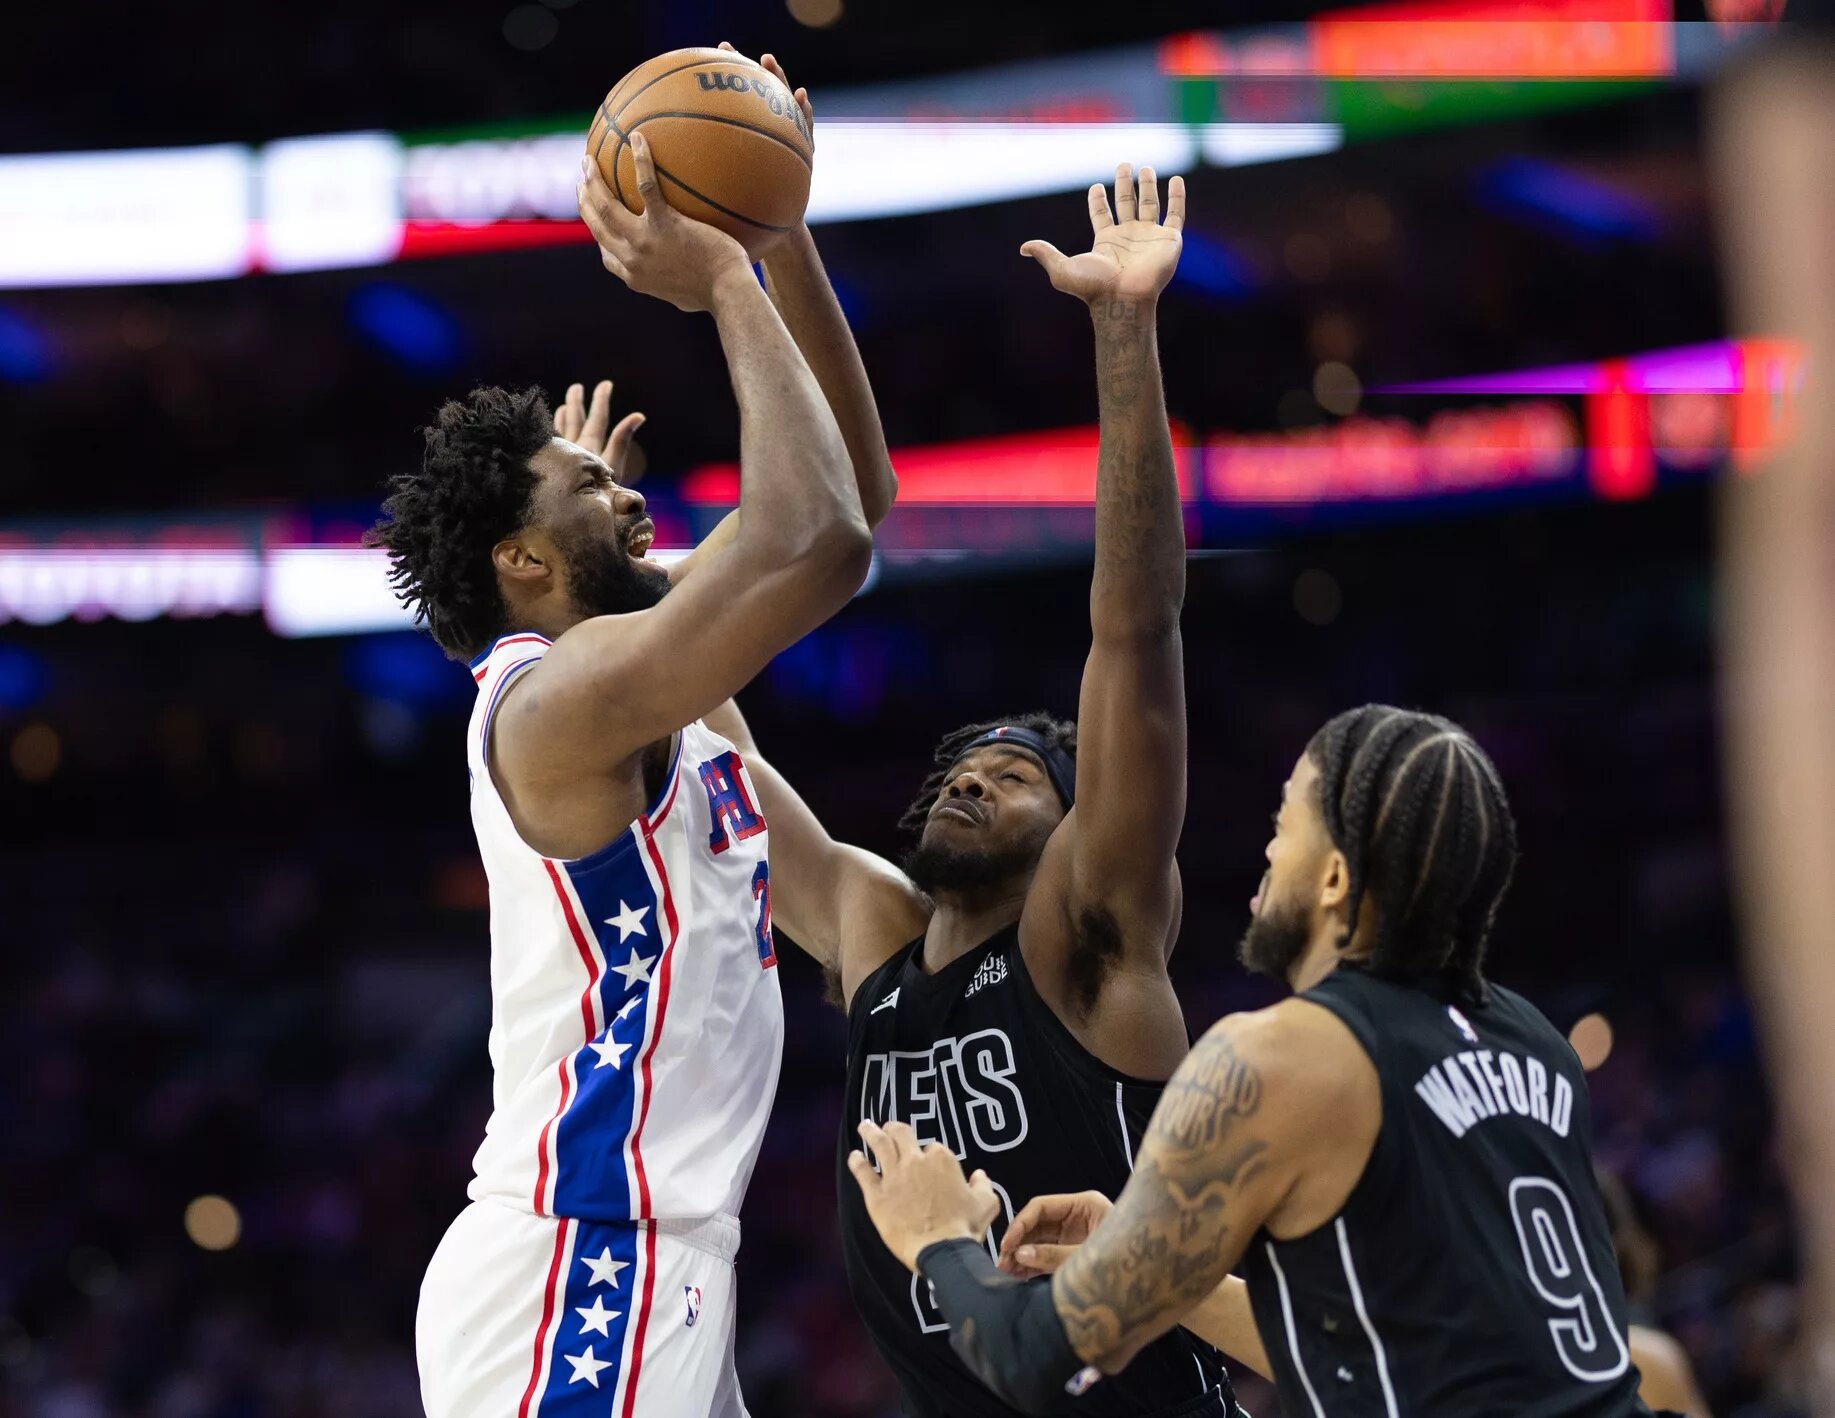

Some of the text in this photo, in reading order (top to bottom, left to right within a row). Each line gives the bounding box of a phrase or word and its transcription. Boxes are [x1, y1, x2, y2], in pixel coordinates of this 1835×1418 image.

[965, 963, 1008, 998] GUIDE
[861, 1028, 1029, 1173] NETS
[1414, 1049, 1574, 1139] WATFORD
[1509, 1176, 1630, 1382] 9
